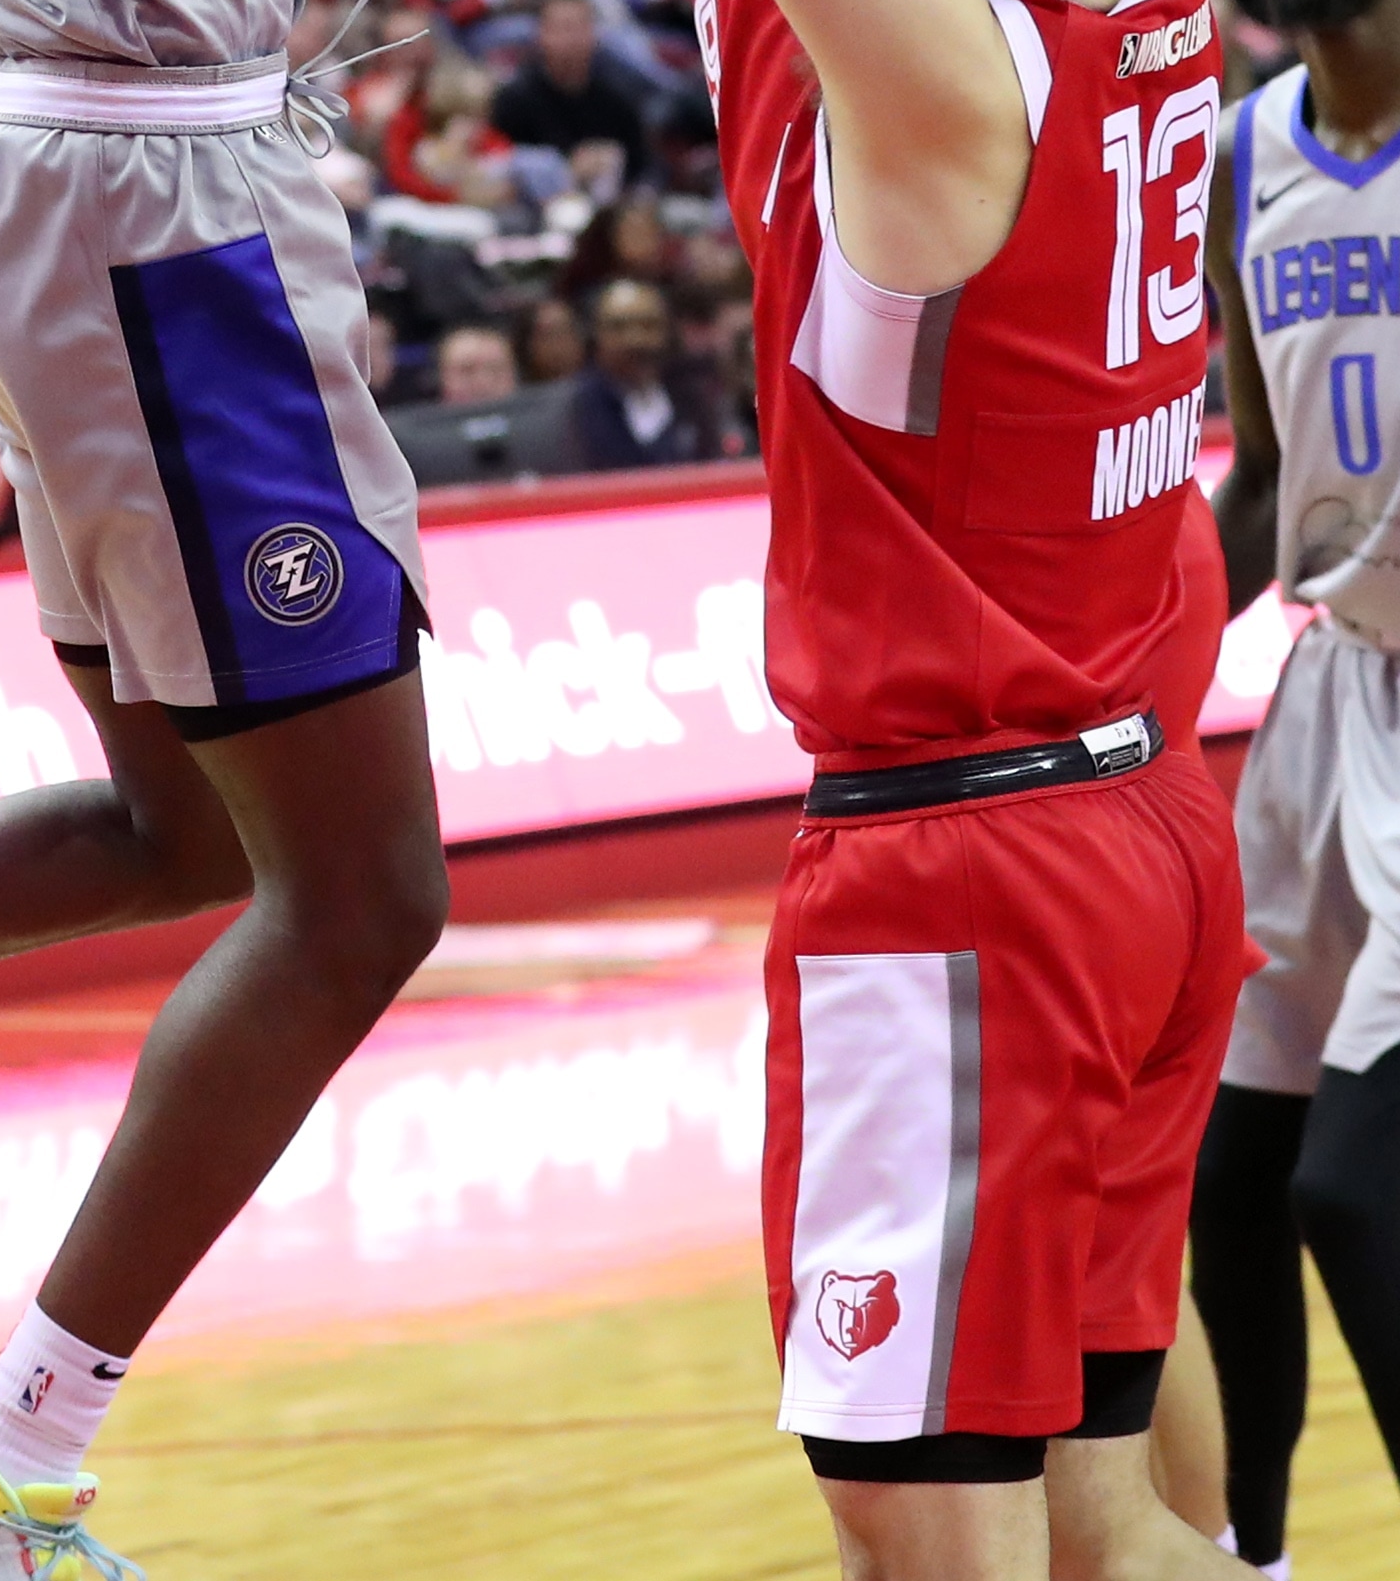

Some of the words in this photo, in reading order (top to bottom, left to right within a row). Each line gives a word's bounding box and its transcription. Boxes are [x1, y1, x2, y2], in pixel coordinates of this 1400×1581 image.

[1103, 75, 1221, 370] 13
[1091, 374, 1207, 521] MOONE
[1329, 351, 1383, 476] 0
